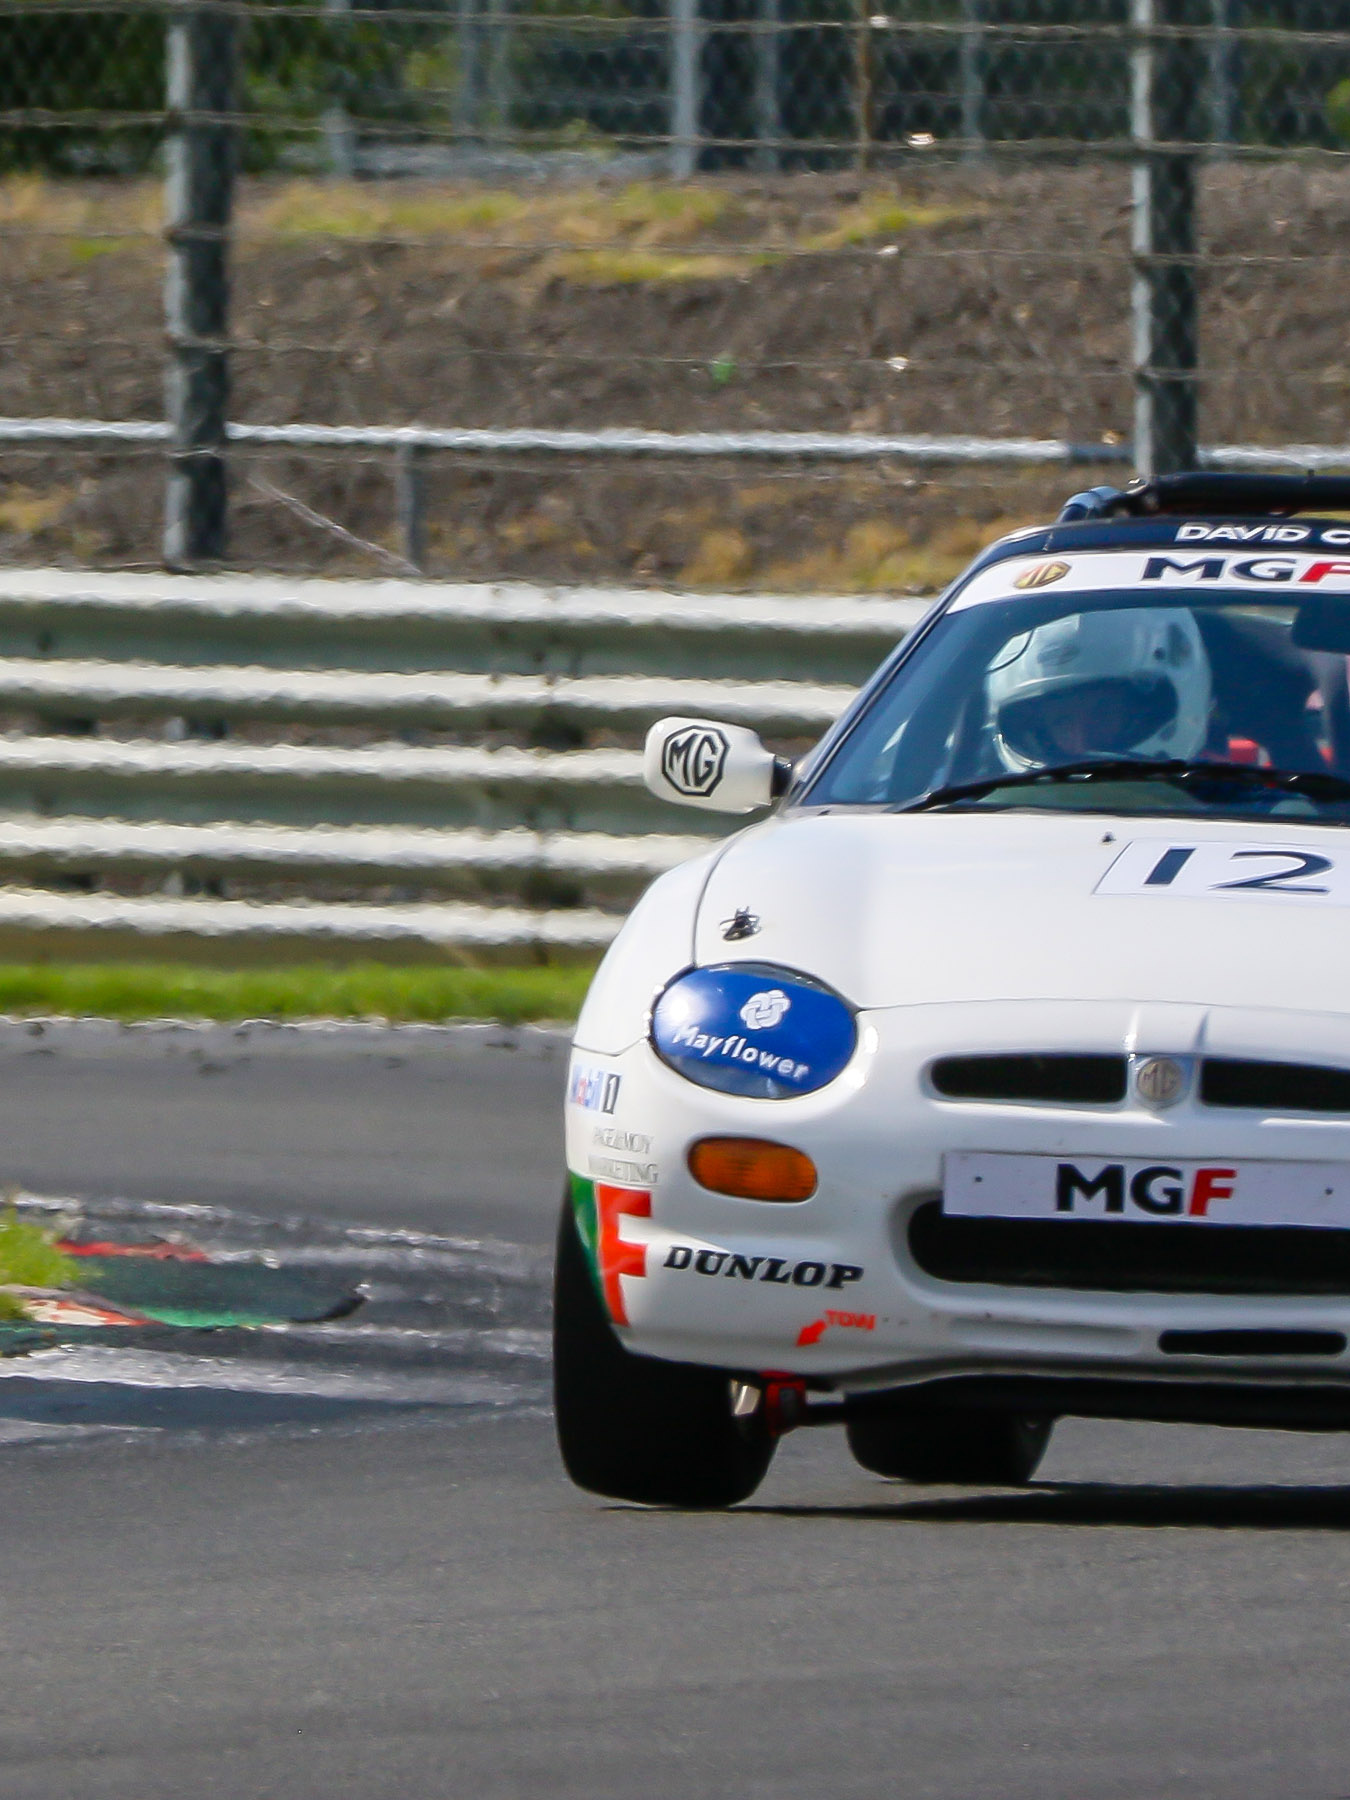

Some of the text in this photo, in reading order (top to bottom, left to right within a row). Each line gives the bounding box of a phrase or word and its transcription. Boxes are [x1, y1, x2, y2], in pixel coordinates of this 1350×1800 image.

[1176, 523, 1312, 544] DAVID
[667, 729, 722, 790] MG
[1143, 848, 1334, 894] 12
[672, 1024, 811, 1081] Mayflower
[1056, 1163, 1238, 1217] MGF
[663, 1245, 865, 1290] DUNLOP
[824, 1309, 877, 1331] TOW
